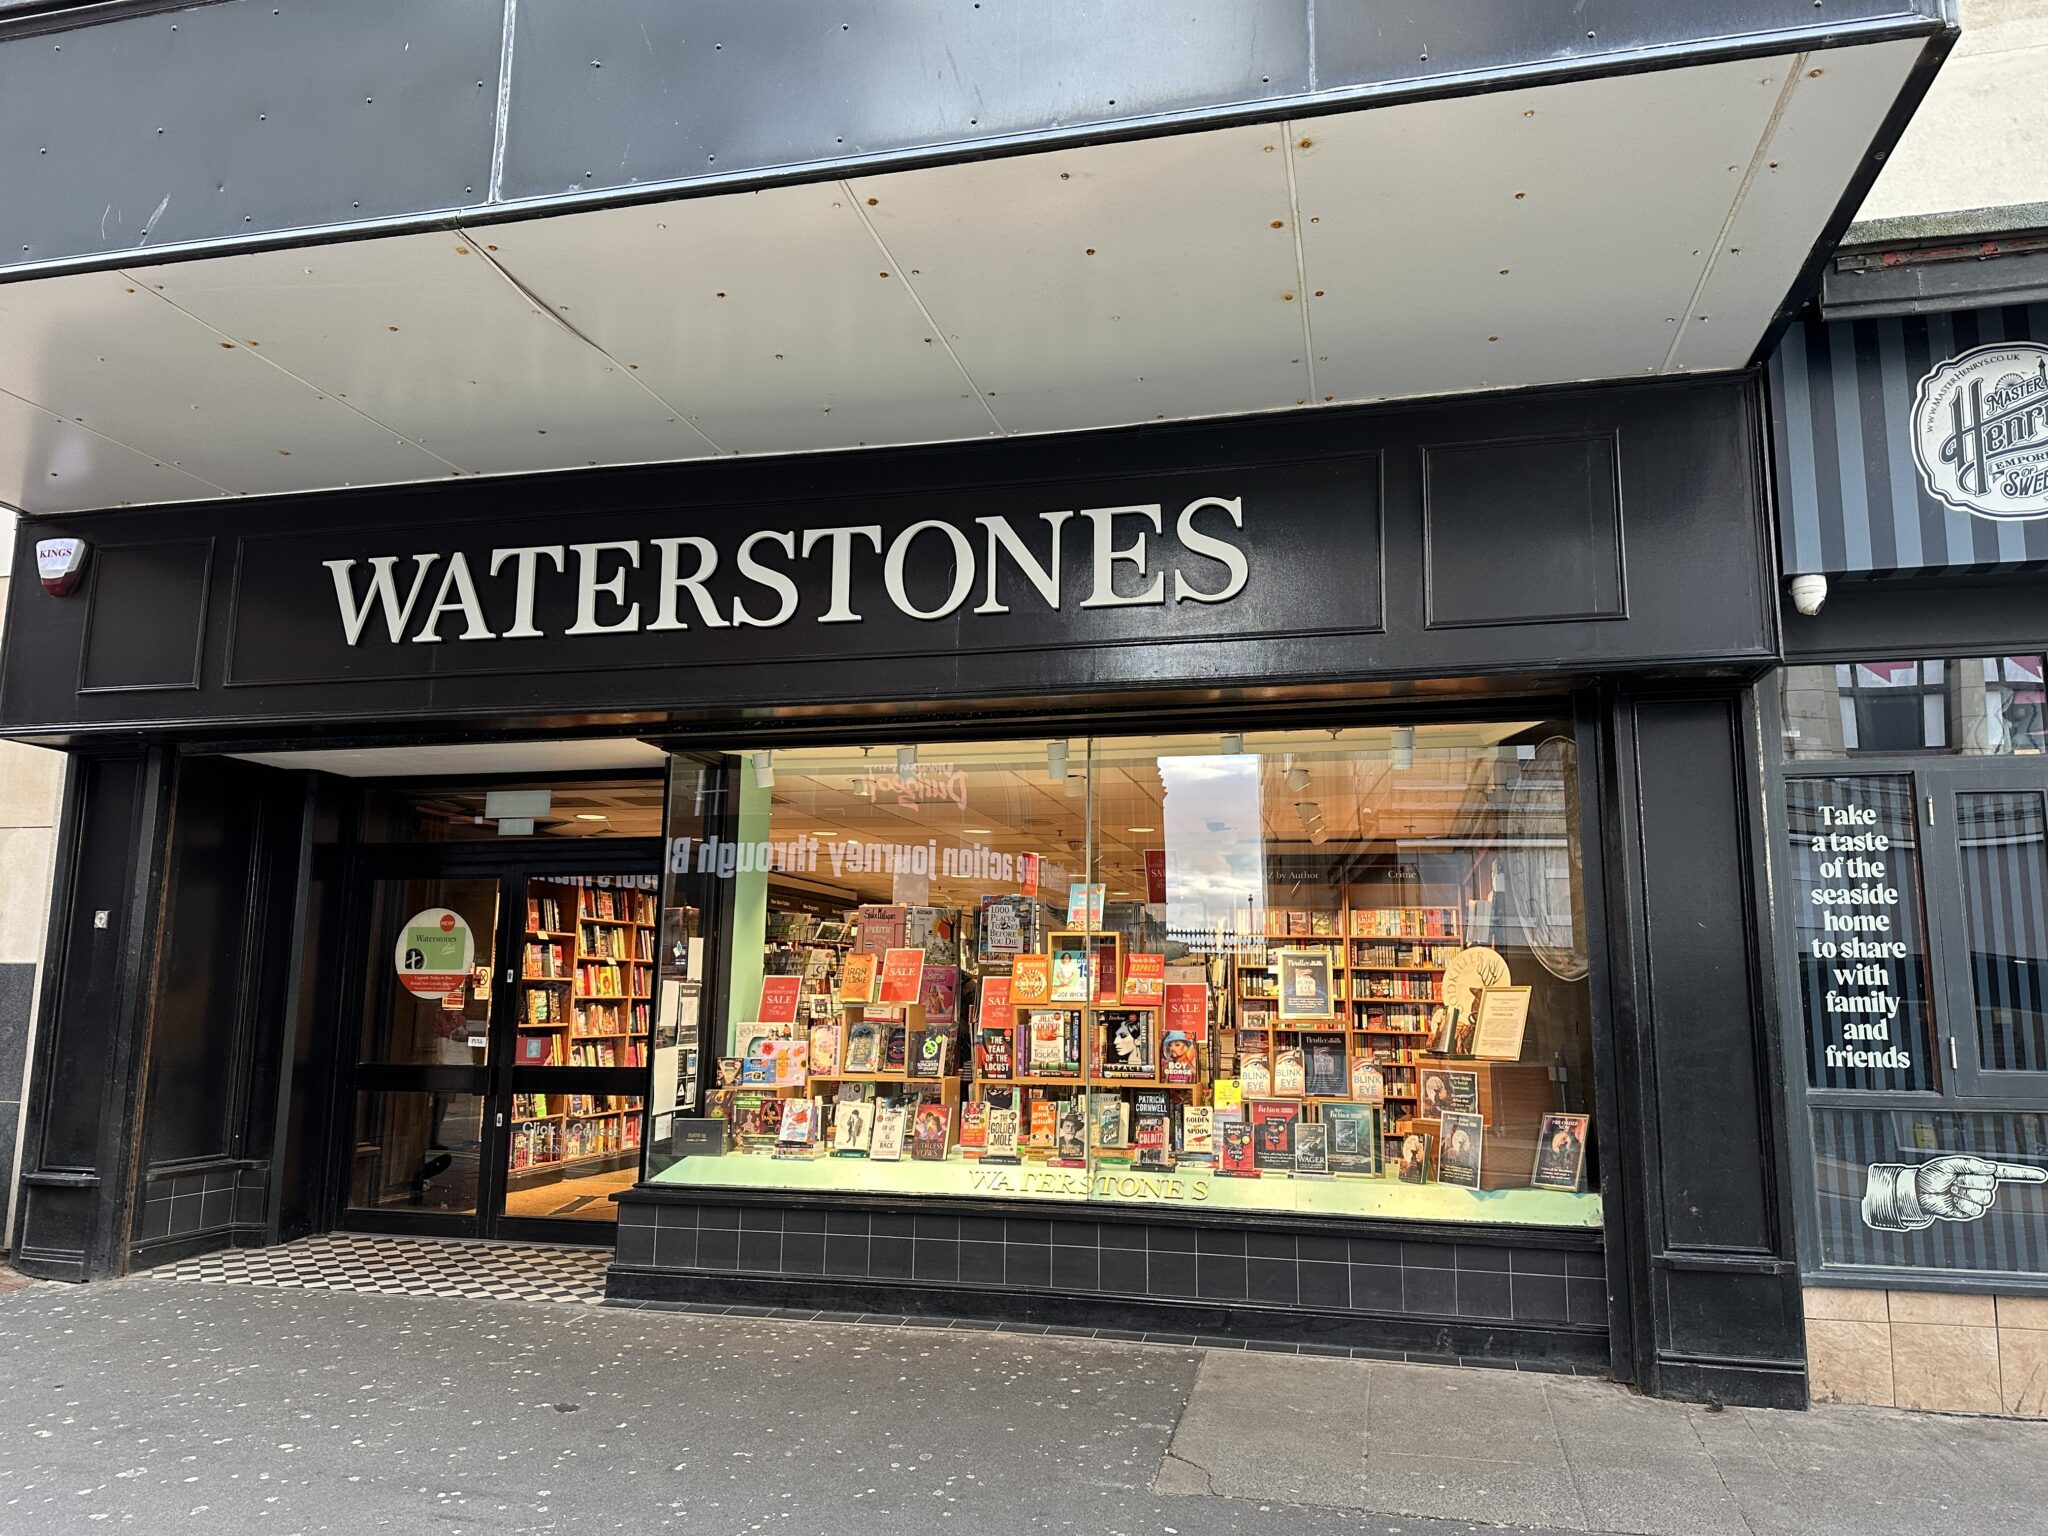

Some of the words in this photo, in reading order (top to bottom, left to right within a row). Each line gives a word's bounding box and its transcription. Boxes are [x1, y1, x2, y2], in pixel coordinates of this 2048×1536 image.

[1986, 376, 2044, 412] MASTER
[1940, 378, 2048, 496] Henr
[40, 548, 72, 559] KINGS
[322, 496, 1249, 646] WATERSTONES
[1818, 804, 1877, 826] Take
[1811, 836, 1826, 852] a
[1829, 831, 1889, 852] taste
[1819, 857, 1844, 878] of
[1846, 857, 1885, 878] the
[1276, 871, 1286, 882] by
[1288, 870, 1319, 880] Author
[1388, 869, 1417, 880] Crime
[1811, 883, 1899, 905] seaside
[1823, 910, 1890, 932] home
[416, 934, 457, 943] Waterstones
[990, 930, 1016, 938] BEFORE
[1811, 938, 1837, 959] to
[1840, 937, 1907, 959] share
[1016, 962, 1024, 974] 5
[1131, 964, 1160, 972] EXPRESS
[1288, 959, 1309, 967] Thriller
[889, 968, 916, 976] SALE
[1833, 963, 1889, 986] with
[766, 995, 792, 1004] SALE
[987, 997, 1010, 1006] SAL
[1826, 990, 1900, 1019] family
[1171, 1004, 1200, 1012] SALE
[1033, 1023, 1060, 1031] COOPER
[1843, 1018, 1889, 1041] and
[990, 1036, 1003, 1044] THE
[988, 1045, 1005, 1053] YEAR
[1033, 1048, 1060, 1058] Tackle!
[985, 1054, 994, 1062] OF
[996, 1054, 1008, 1062] THE
[1825, 1045, 1911, 1070] friends
[984, 1063, 1009, 1072] LOCUST
[1242, 1072, 1268, 1080] BLINK
[1276, 1069, 1302, 1077] BLINK
[1280, 1079, 1297, 1087] EYE
[1354, 1075, 1382, 1084] BLINK
[1247, 1082, 1264, 1090] EYE
[1360, 1086, 1377, 1094] EYE
[1138, 1095, 1165, 1104] PATRICIA
[1135, 1103, 1168, 1113] CORNWELL
[1000, 1113, 1009, 1121] THE
[522, 1121, 556, 1136] Click
[990, 1122, 1017, 1134] GOLDEN
[993, 1135, 1012, 1146] MOLE
[1139, 1131, 1163, 1144] COLDITZ
[916, 1148, 938, 1157] VOWS
[1297, 1156, 1325, 1164] WAGER
[967, 1169, 1210, 1201] WATERSTONES
